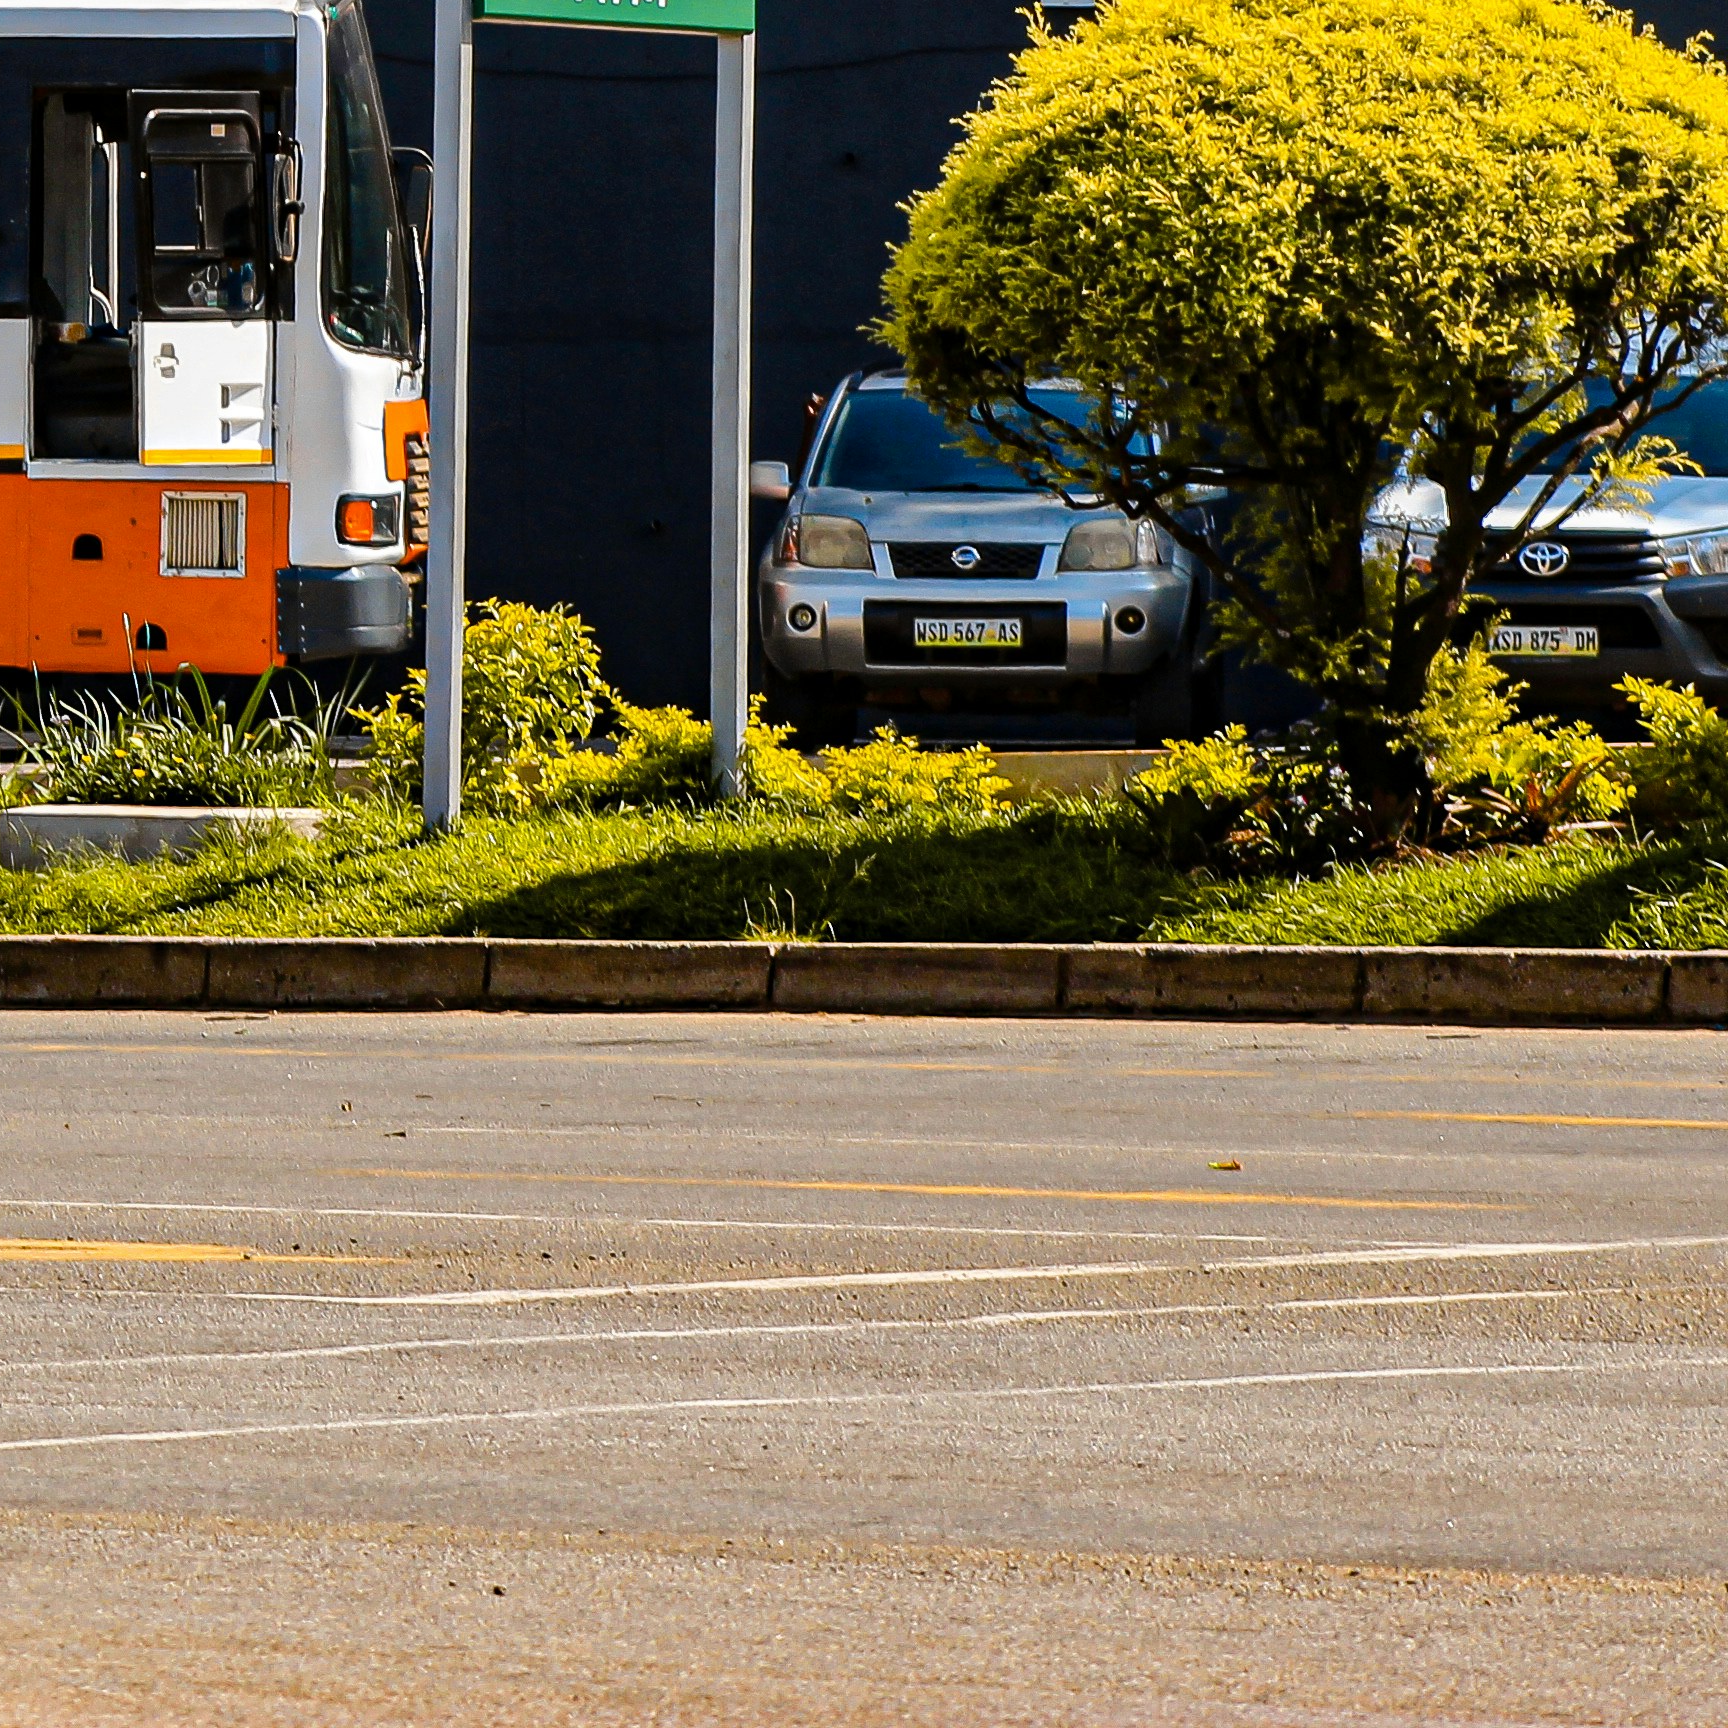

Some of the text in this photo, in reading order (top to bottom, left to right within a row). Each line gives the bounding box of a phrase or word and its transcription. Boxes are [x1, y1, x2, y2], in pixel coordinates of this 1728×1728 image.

[916, 622, 1020, 643] WSD 567 AS
[1530, 631, 1561, 652] 875
